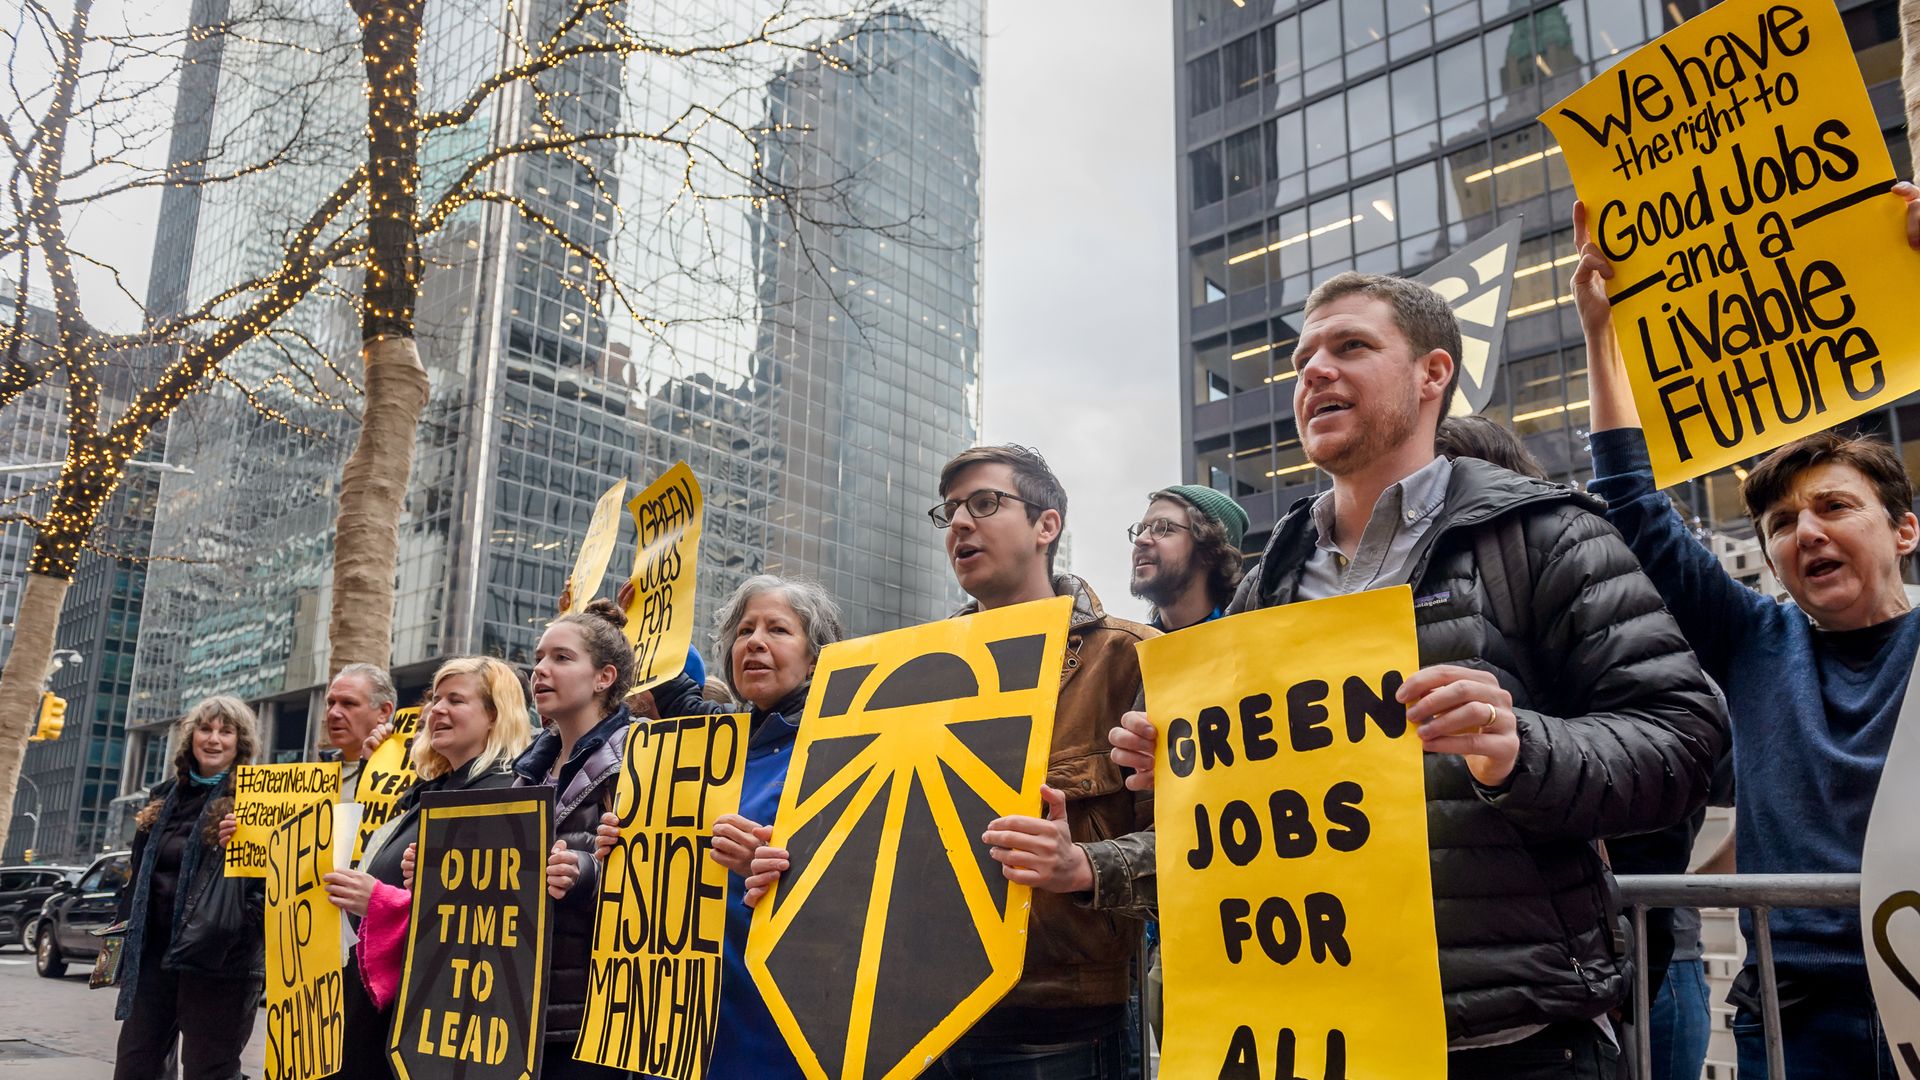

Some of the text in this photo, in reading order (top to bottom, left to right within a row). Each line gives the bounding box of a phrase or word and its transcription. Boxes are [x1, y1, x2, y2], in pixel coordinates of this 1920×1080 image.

[1560, 5, 1810, 148] We have
[1755, 72, 1799, 113] to
[1598, 119, 1859, 262] Good Jobs
[1665, 211, 1795, 293] and a
[1638, 257, 1856, 382] Livable
[639, 477, 694, 549] GREEN
[640, 535, 683, 593] JOBS
[1415, 598, 1448, 608] atagonia
[638, 584, 673, 641] FOR
[1167, 669, 1408, 778] GREEN
[616, 716, 740, 831] STEP
[267, 799, 334, 907] STEP
[1187, 781, 1371, 870] JOBS
[440, 848, 522, 890] OUR
[593, 831, 724, 955] ASIDE
[279, 899, 312, 988] UP
[437, 905, 519, 947] TIME
[1219, 892, 1352, 966] FOR
[450, 959, 494, 1002] TO
[574, 956, 722, 1080] MANCHIN
[265, 970, 342, 1080] SCHUMER
[417, 1008, 509, 1065] LEAD
